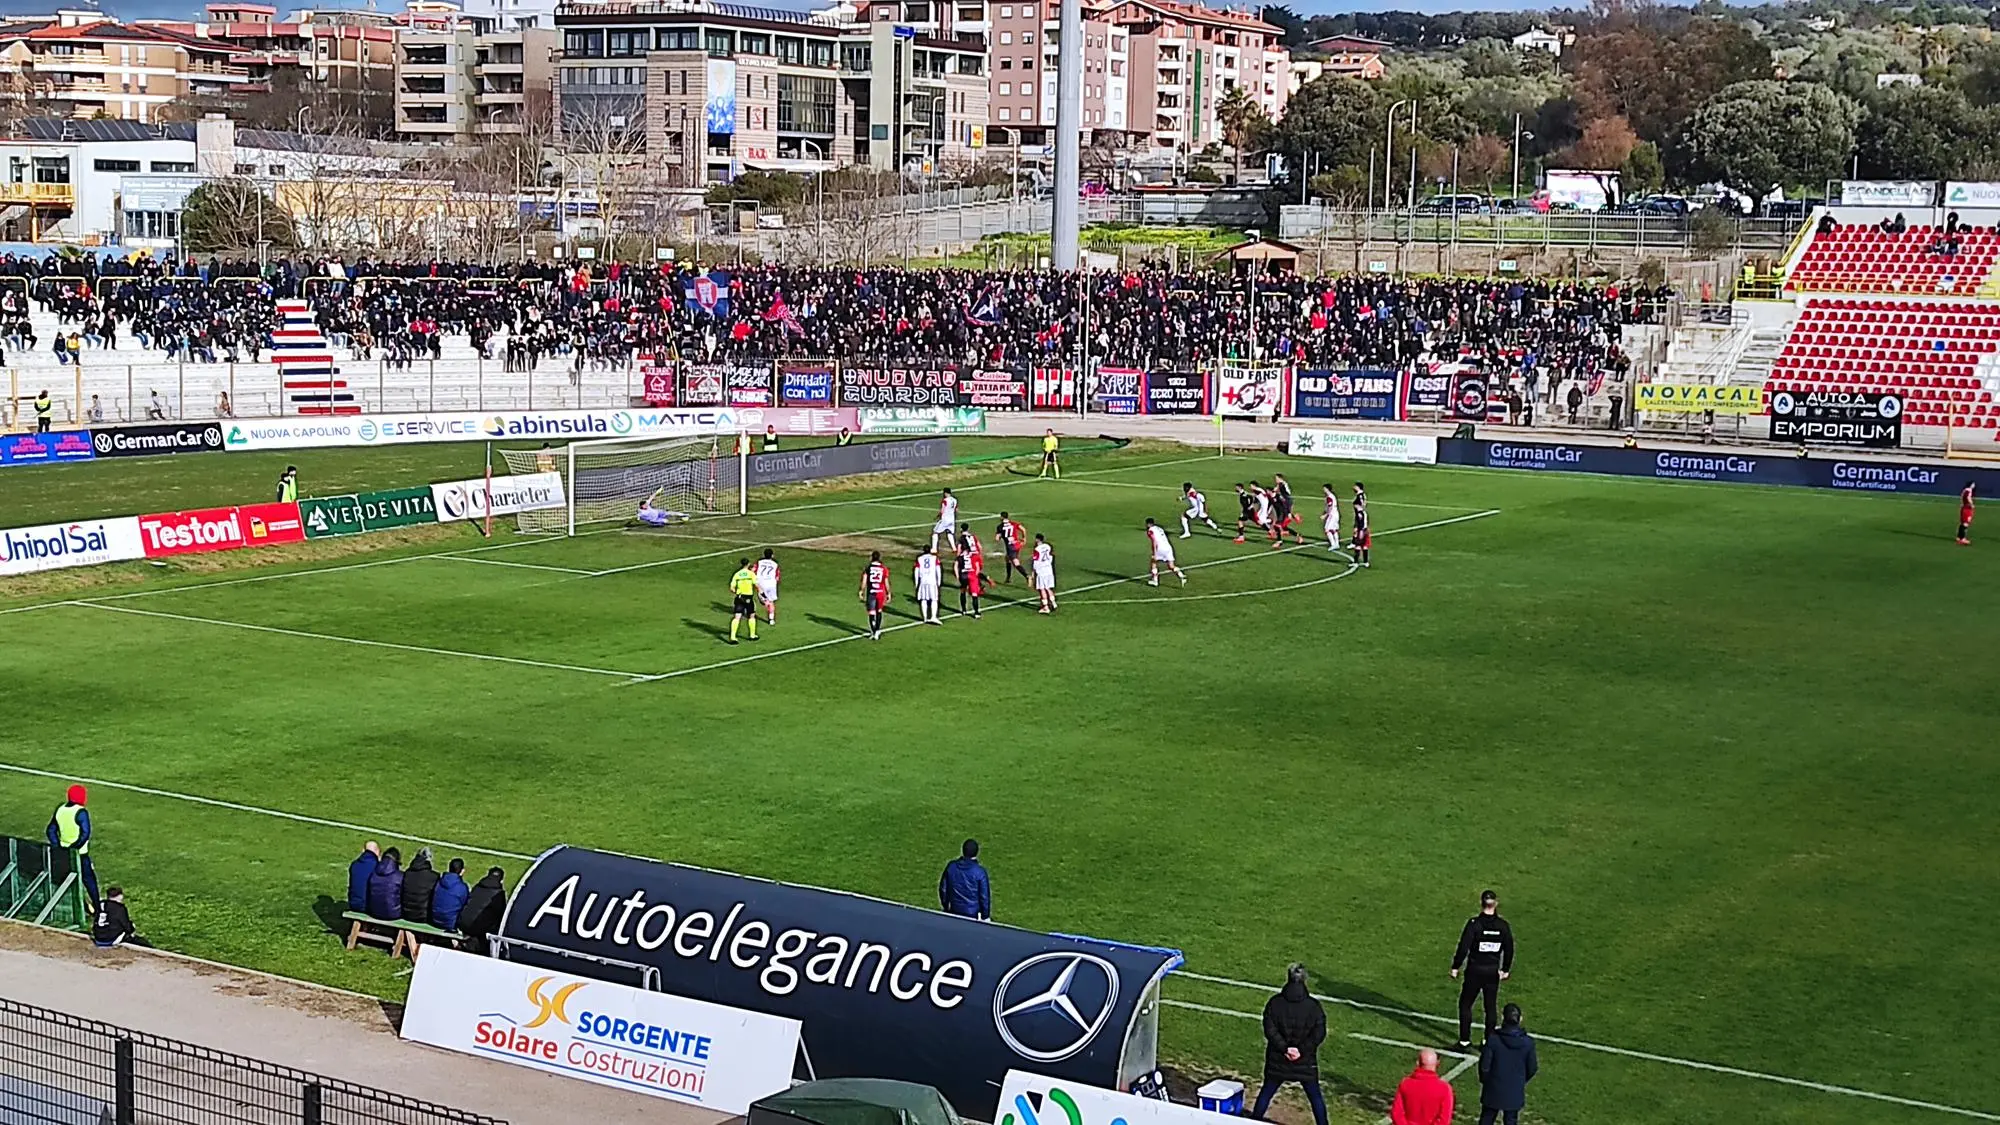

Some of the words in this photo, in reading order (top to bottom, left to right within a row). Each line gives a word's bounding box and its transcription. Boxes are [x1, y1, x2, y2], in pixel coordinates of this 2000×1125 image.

[1223, 368, 1244, 380] OLD
[1248, 370, 1278, 380] FANS
[1299, 377, 1328, 392] OLD
[1354, 378, 1393, 393] FANS
[1413, 377, 1448, 391] OSSI
[844, 386, 955, 404] GUARDIA
[1150, 388, 1174, 399] ZERO
[1175, 388, 1204, 399] TESTA
[1640, 386, 1758, 401] NOVACAL
[1806, 392, 1851, 405] AUTO
[1853, 393, 1866, 404] A
[509, 414, 607, 435] abinsula
[638, 413, 733, 426] MATICA
[251, 428, 290, 440] NUOVA
[293, 426, 350, 438] CAPOLINO
[1775, 421, 1895, 439] EMPORIUM
[114, 431, 202, 450] GermanCar
[1323, 433, 1409, 446] DISINFESTAZIONI
[870, 440, 931, 460] GermanCar
[1490, 443, 1582, 462] GermanCar
[755, 452, 822, 473] GermanCar
[1656, 452, 1756, 473] GermanCar
[1833, 463, 1939, 483] GermanCar
[471, 484, 551, 511] Character
[142, 512, 241, 550] Testoni
[760, 564, 774, 576] 77
[528, 874, 974, 1010] Autoelegance
[577, 1010, 712, 1061] SORGENTE
[474, 1021, 559, 1060] Solare
[566, 1042, 706, 1093] Costruzioni
